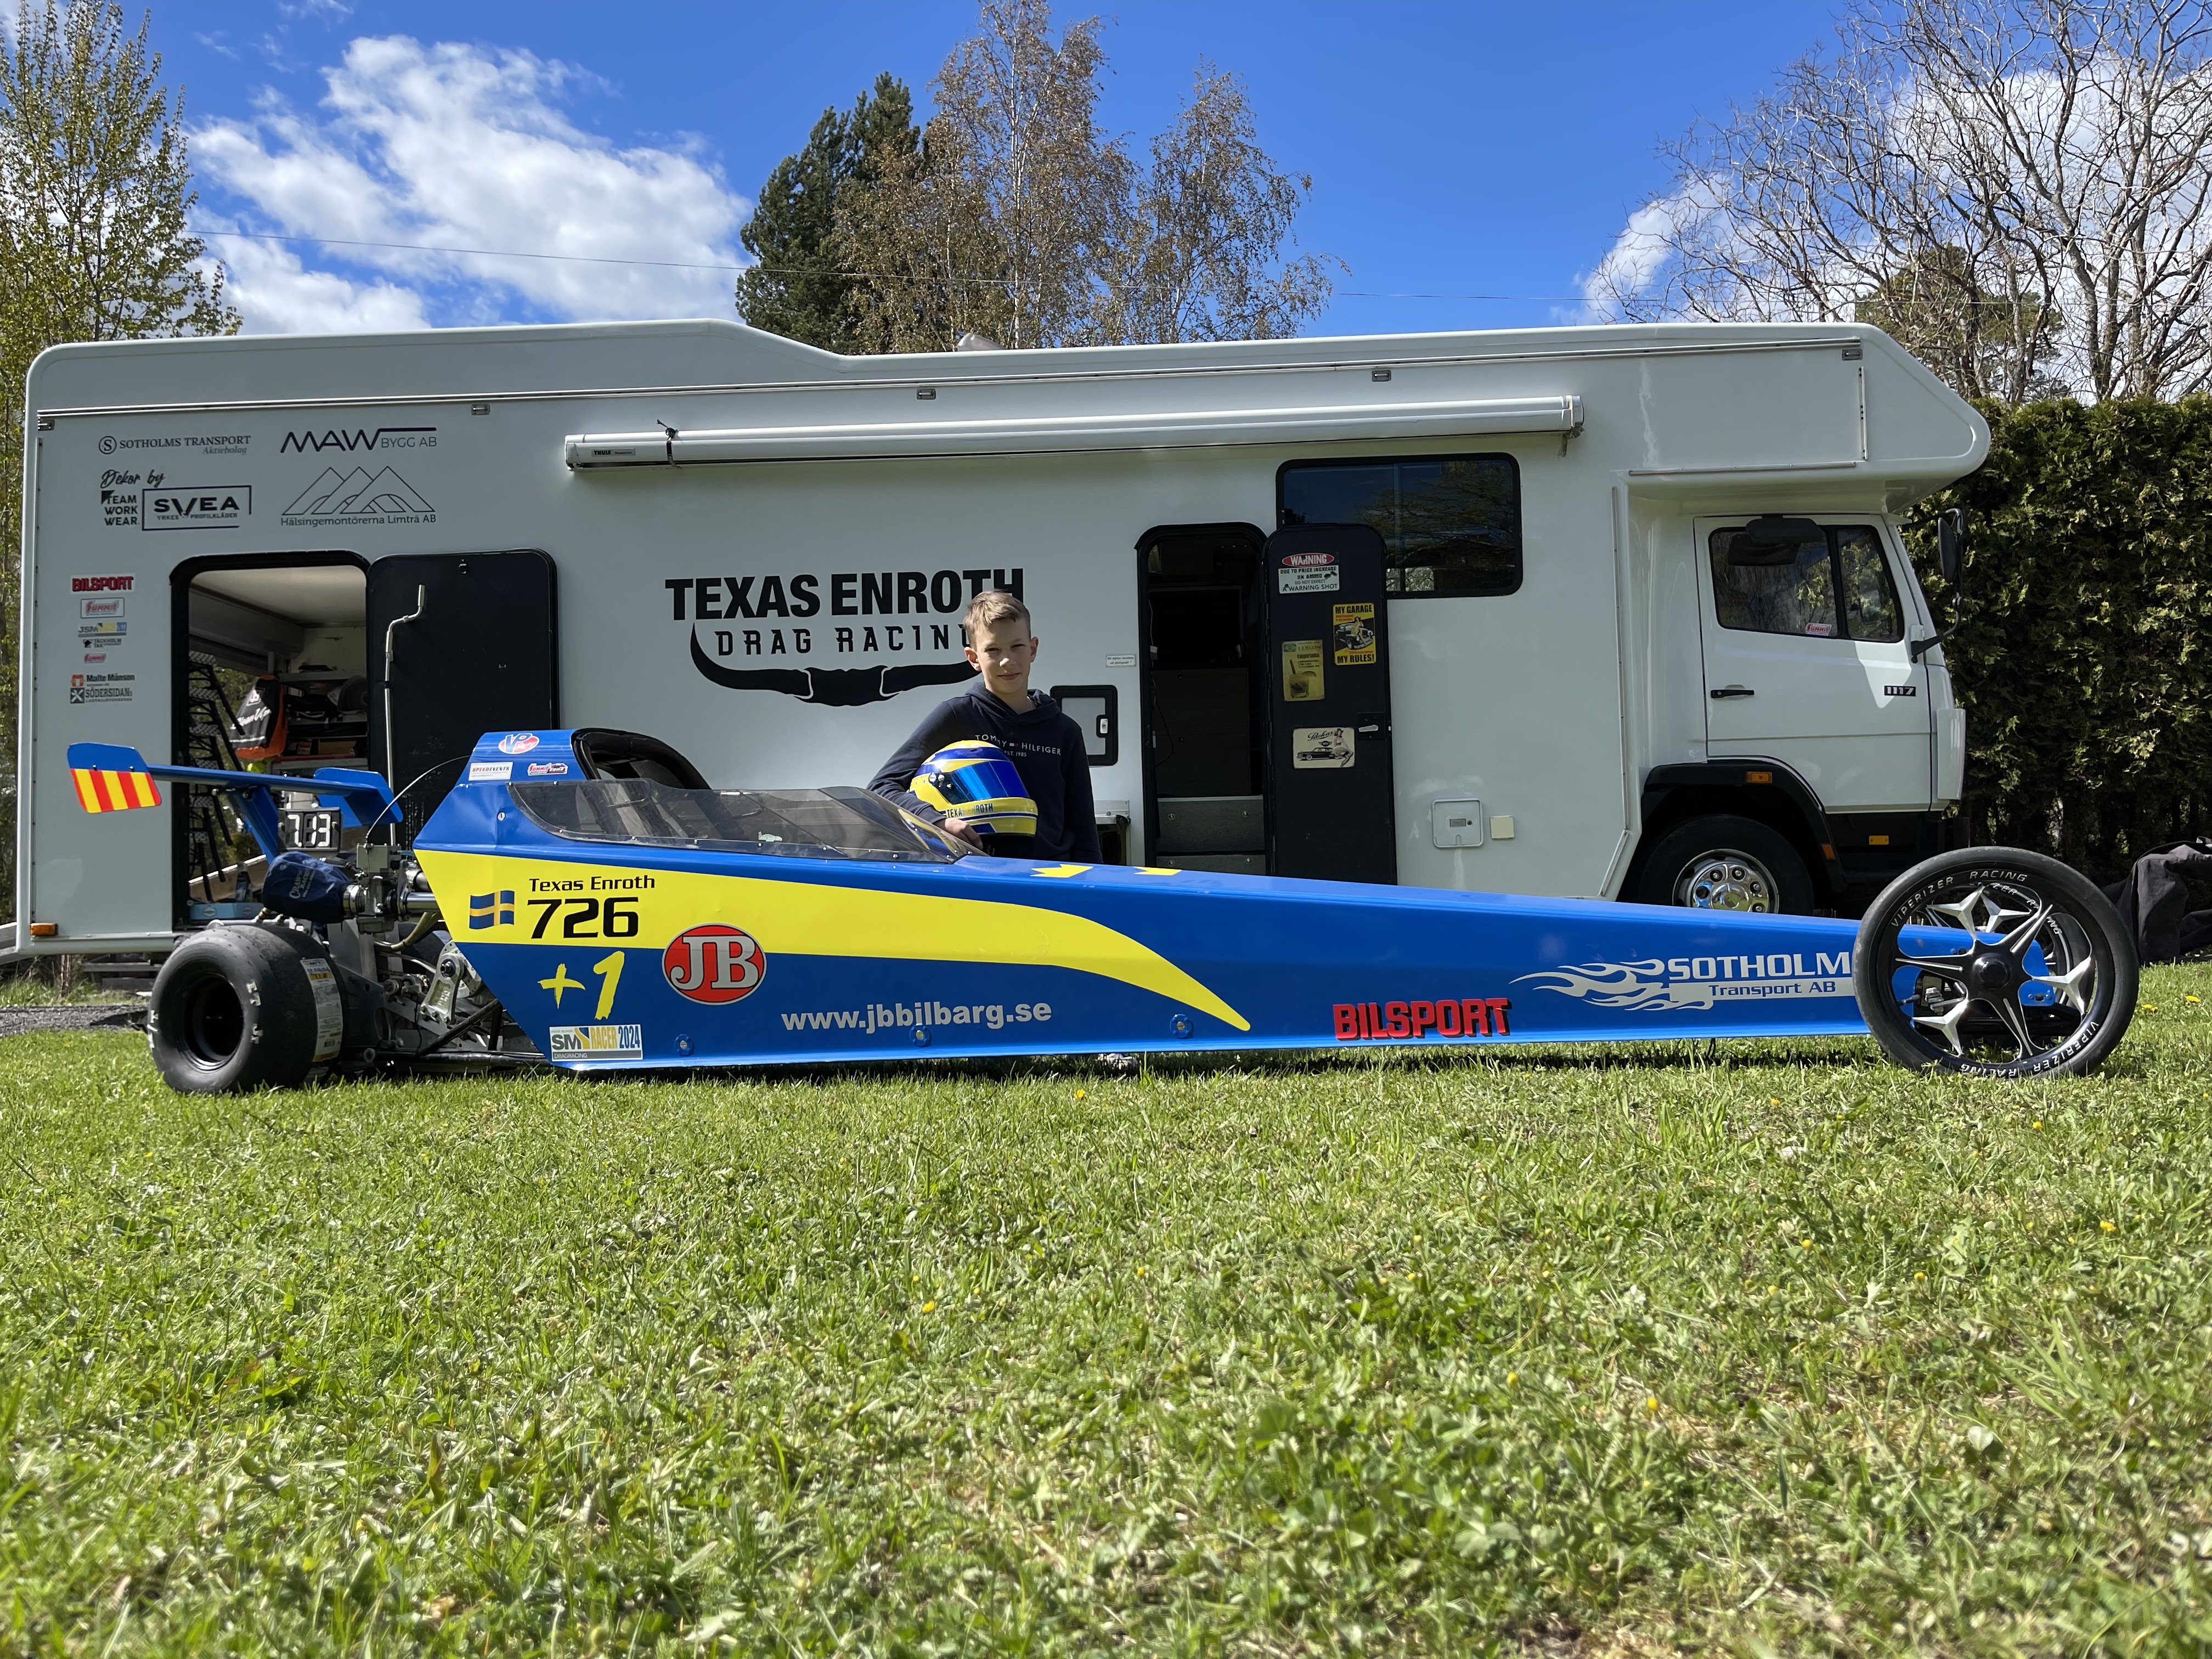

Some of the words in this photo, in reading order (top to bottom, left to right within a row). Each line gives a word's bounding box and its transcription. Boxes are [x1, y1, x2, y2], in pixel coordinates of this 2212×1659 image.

[120, 438, 182, 449] SOTHOLMS
[184, 435, 251, 447] TRANSPORT
[280, 428, 381, 453] MAW
[381, 437, 416, 448] BYGG
[419, 437, 437, 447] AB
[100, 469, 141, 488] Dekor
[147, 469, 166, 488] by
[102, 492, 137, 504] TEAM
[154, 496, 240, 516] SVEA
[104, 505, 138, 515] WORK
[104, 517, 138, 526] WEAR
[280, 516, 385, 528] Hälsingemontörerna
[387, 515, 420, 524] Limträ
[422, 514, 437, 523] AB
[1290, 555, 1327, 566] WARNING
[72, 576, 134, 592] BILSPORT
[665, 574, 821, 621] TEXAS
[831, 568, 1024, 616] ENROTH
[1347, 605, 1373, 613] GARAGE
[714, 628, 811, 656] DRAG
[1338, 655, 1348, 663] MY
[1350, 654, 1374, 663] RULES!
[1887, 687, 1914, 695] 1117
[505, 732, 533, 754] VP
[975, 734, 1007, 747] TOMMY
[1022, 742, 1061, 755] HILFIGER
[1307, 730, 1336, 742] Packar
[946, 808, 966, 819] TEXAS
[529, 878, 584, 893] Texas
[591, 875, 656, 890] Enroth
[1891, 876, 1954, 927] VIPERIZER
[1970, 870, 2028, 882] RACING
[527, 896, 639, 939] 726
[670, 935, 760, 991] JB
[1668, 952, 1850, 980] SOTHOLM
[1709, 983, 1803, 997] Transport
[1809, 981, 1836, 992] AB
[781, 1002, 1052, 1034] www.jbbilbarg.se
[1333, 998, 1511, 1041] BILSPORT
[552, 1034, 582, 1050] SM
[590, 1026, 618, 1049] RACER
[618, 1025, 640, 1049] 2024
